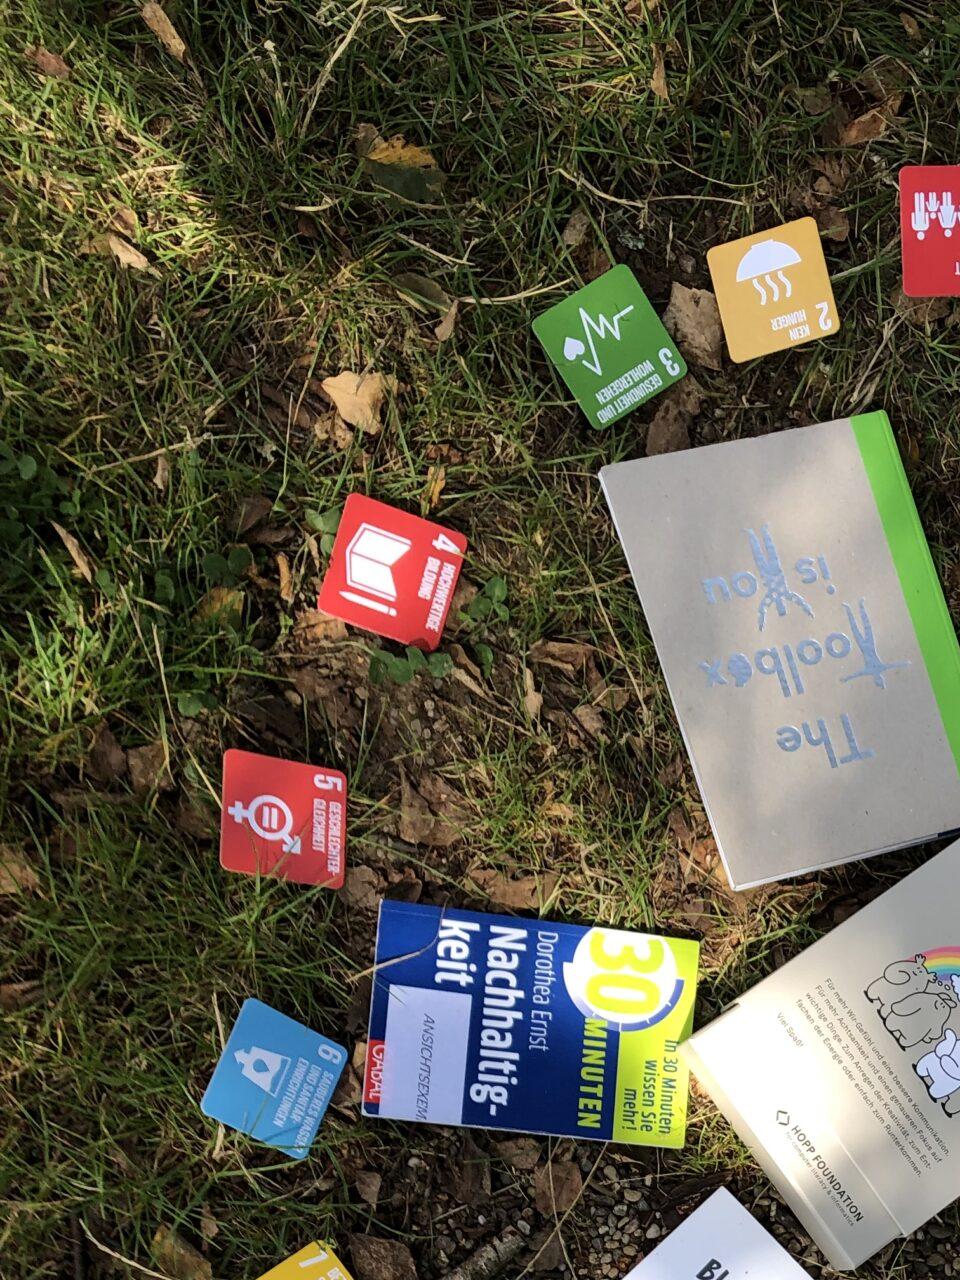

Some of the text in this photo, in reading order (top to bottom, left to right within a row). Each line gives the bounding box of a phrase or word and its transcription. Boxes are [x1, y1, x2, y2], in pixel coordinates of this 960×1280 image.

[771, 309, 806, 331] HUNGER
[789, 324, 810, 340] KEIN
[815, 301, 832, 331] 2
[595, 360, 655, 405] WOHLERGEHEN
[658, 348, 680, 376] 3
[596, 373, 663, 423] GESUNDHEIT UND
[432, 533, 460, 555] 4
[418, 556, 440, 600] BILDUNG
[426, 562, 456, 632] HOCHWERTIGE
[793, 552, 837, 600] is
[773, 708, 876, 778] The
[314, 774, 342, 792] 5
[434, 918, 480, 987] keit
[584, 931, 666, 1017] 30
[470, 925, 528, 1116] Nachhaltig-
[528, 930, 559, 1052] Dorothea Ernst
[318, 1044, 342, 1064] 6
[415, 1013, 435, 1120] ANSICHTSEXEM
[662, 1056, 678, 1073] 30
[824, 978, 913, 1103] Für mehr und eine bessere
[272, 1058, 309, 1128] EINRICHTUNGEN
[306, 1064, 322, 1086] UND
[307, 1071, 334, 1118] SAUBERES
[577, 1017, 610, 1128] MINUTEN
[640, 1060, 659, 1132] wissen Sie
[805, 992, 828, 1022] wichtige
[842, 1043, 855, 1062] Zum
[853, 1061, 875, 1090] Anregen
[874, 1090, 885, 1102] der
[908, 1139, 921, 1155] zum
[815, 984, 826, 998] Für
[824, 998, 839, 1017] mehr
[837, 1017, 870, 1061] Achtsamkeit
[867, 1060, 880, 1075] und
[877, 1075, 893, 1095] einen
[916, 1129, 932, 1151] Fokus
[930, 1151, 943, 1163] auf
[822, 1037, 844, 1065] Energie
[842, 1065, 856, 1082] oder
[854, 1083, 874, 1110] einfach
[872, 1109, 885, 1125] zum
[622, 1088, 639, 1131] mehr!
[658, 1077, 677, 1136] Minuten
[791, 1125, 864, 1222] HOPP FOUNDATION
